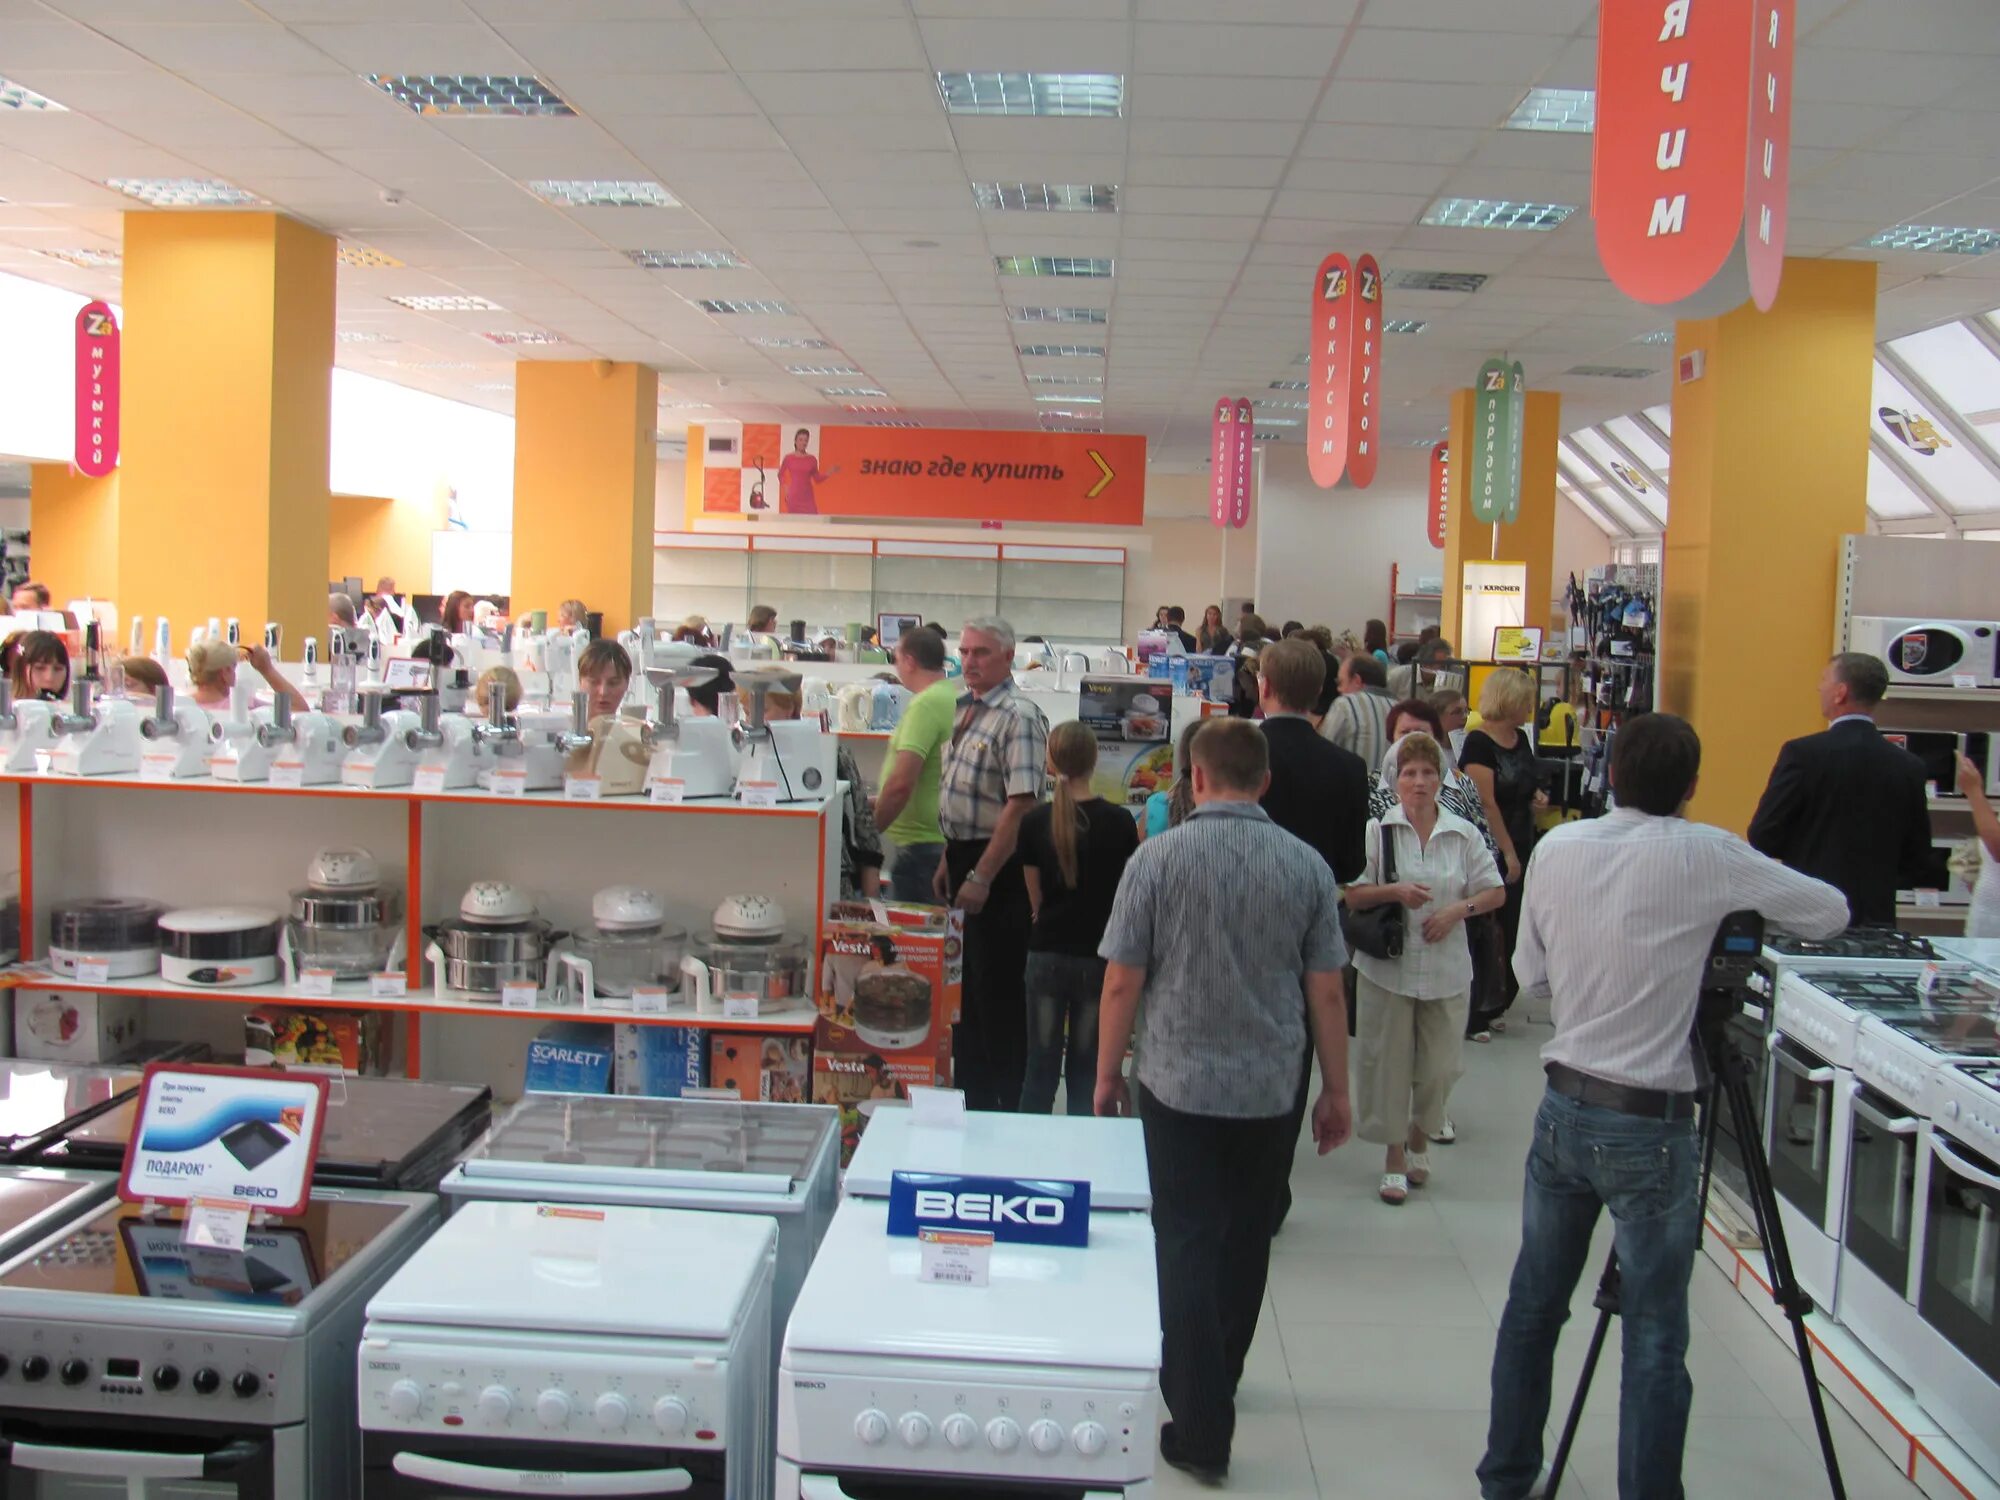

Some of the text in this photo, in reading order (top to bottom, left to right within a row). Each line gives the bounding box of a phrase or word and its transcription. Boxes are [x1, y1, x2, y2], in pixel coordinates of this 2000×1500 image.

[1322, 315, 1336, 455] вкусом
[1358, 317, 1371, 456] вкусом
[91, 347, 104, 465] музыкой
[1482, 398, 1496, 510] порядком
[860, 455, 1064, 484] знаю где купить
[832, 939, 871, 955] Vesta
[532, 1044, 603, 1066] SCARLETT
[827, 1057, 865, 1073] Vesta
[146, 1159, 205, 1176] ПОДАРОК!
[233, 1184, 278, 1199] BEKO
[915, 1190, 1065, 1225] BEKO
[794, 1381, 826, 1389] BEKO
